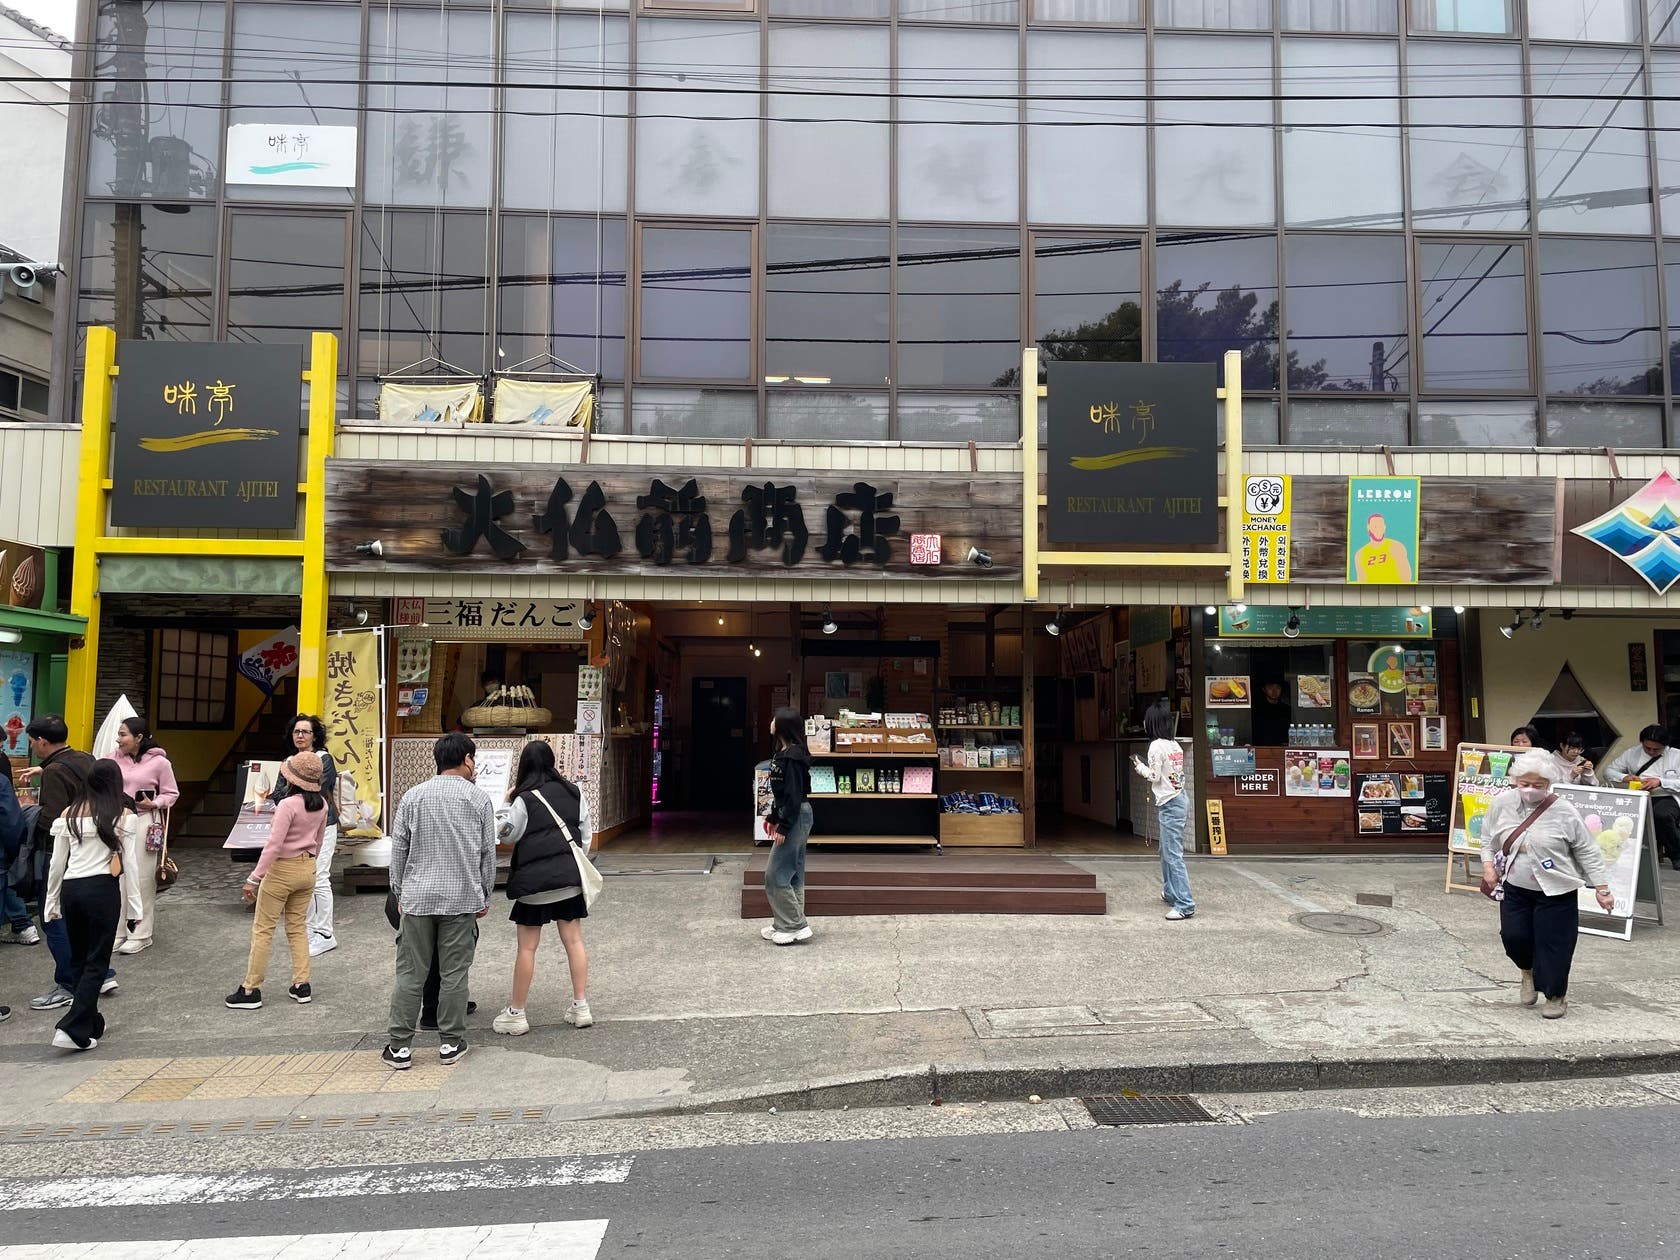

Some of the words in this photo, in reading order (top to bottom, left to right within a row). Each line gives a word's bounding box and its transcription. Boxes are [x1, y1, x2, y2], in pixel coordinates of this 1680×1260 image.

[133, 479, 229, 497] RESTAURANT
[236, 481, 279, 502] AJITEI
[1357, 489, 1412, 499] LEBRON
[1067, 496, 1153, 513] RESTAURANT
[1163, 497, 1202, 519] AJITEI
[1367, 553, 1387, 566] 23
[427, 600, 577, 627] 三福だんご
[1241, 774, 1274, 782] ORDER
[1241, 783, 1269, 791] HERE
[1574, 801, 1613, 811] Strawberry
[1597, 810, 1640, 818] YuzuLemon
